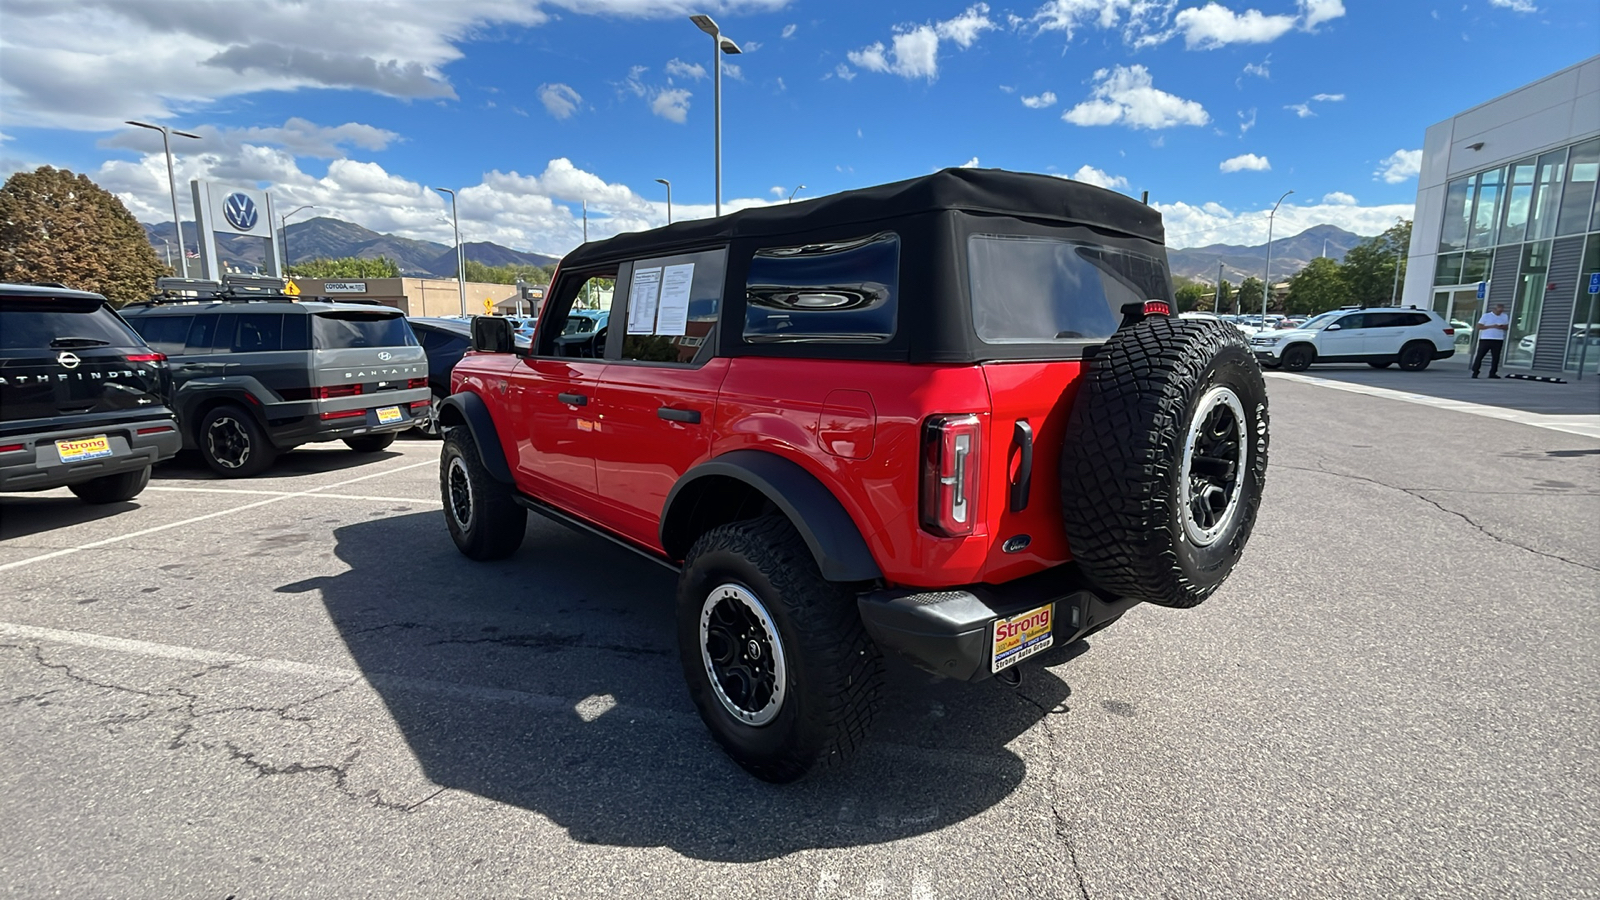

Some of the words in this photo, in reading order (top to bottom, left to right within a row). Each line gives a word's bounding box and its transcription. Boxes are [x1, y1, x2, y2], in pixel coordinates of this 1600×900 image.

[345, 368, 398, 378] SANTA
[61, 440, 105, 451] Strong
[996, 610, 1050, 643] Strong
[996, 655, 1017, 671] Strong
[1018, 647, 1032, 660] Auto
[1033, 639, 1051, 652] Group
